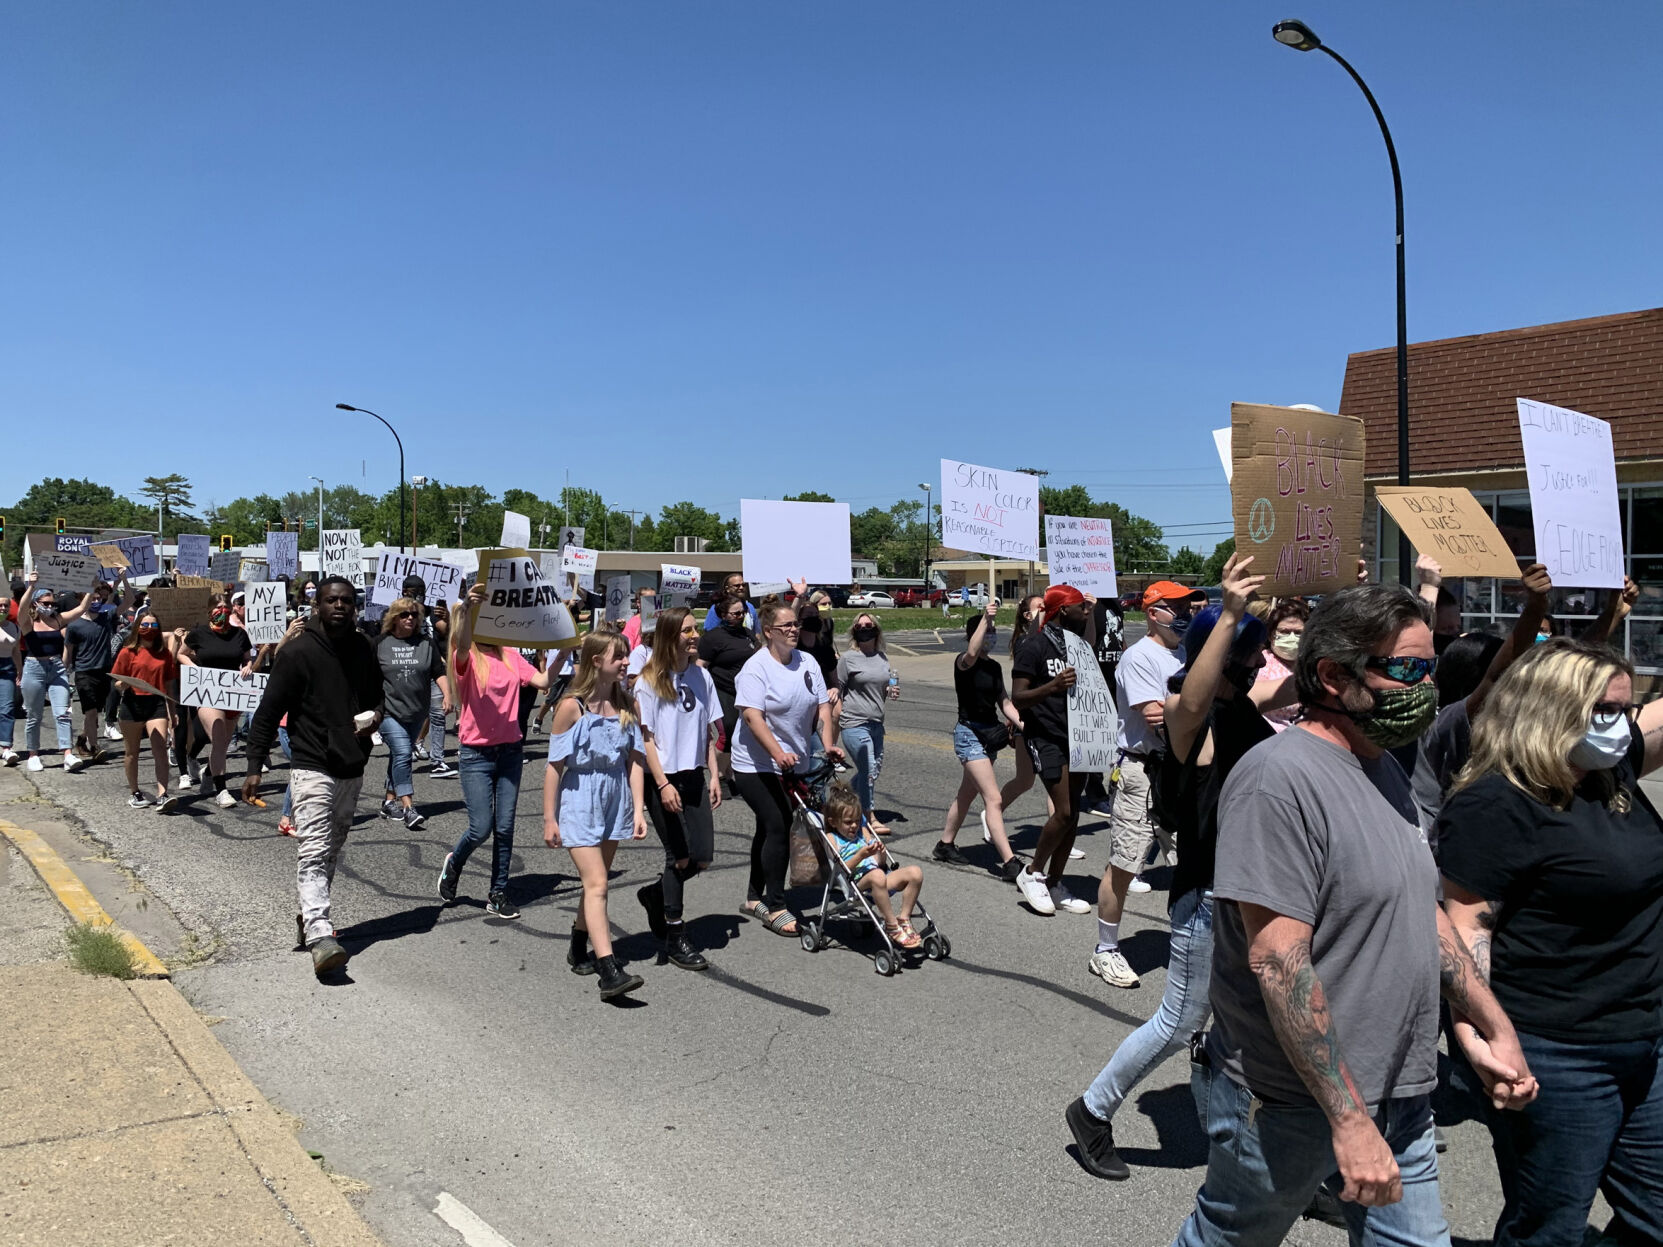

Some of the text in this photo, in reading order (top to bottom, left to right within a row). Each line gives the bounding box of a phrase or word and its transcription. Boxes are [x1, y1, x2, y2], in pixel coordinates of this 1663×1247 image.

[1275, 427, 1345, 500] BLACK
[954, 463, 998, 491] SKIN
[994, 492, 1036, 512] COLOR
[951, 500, 1009, 528] IS NOT
[1295, 501, 1333, 542] LIVES
[1421, 515, 1462, 530] LIVES
[1080, 520, 1108, 532] NEUTRAL
[58, 536, 90, 546] ROYAL
[324, 531, 360, 547] NOW IS
[48, 555, 85, 569] Justice
[325, 547, 348, 562] NOT
[1274, 536, 1341, 588] MATTER
[61, 568, 70, 577] 4
[382, 554, 389, 573] I
[393, 556, 460, 586] MATTER
[669, 567, 693, 576] BLACK
[665, 580, 693, 590] MATTER
[252, 586, 277, 605] MY
[653, 593, 673, 610] WE
[247, 605, 282, 623] LIFE
[247, 624, 285, 641] MATTERS
[182, 686, 264, 709] MATTE
[1069, 686, 1113, 714] BROKEN
[1080, 713, 1109, 729] IT WAS
[1073, 727, 1096, 744] BUILT
